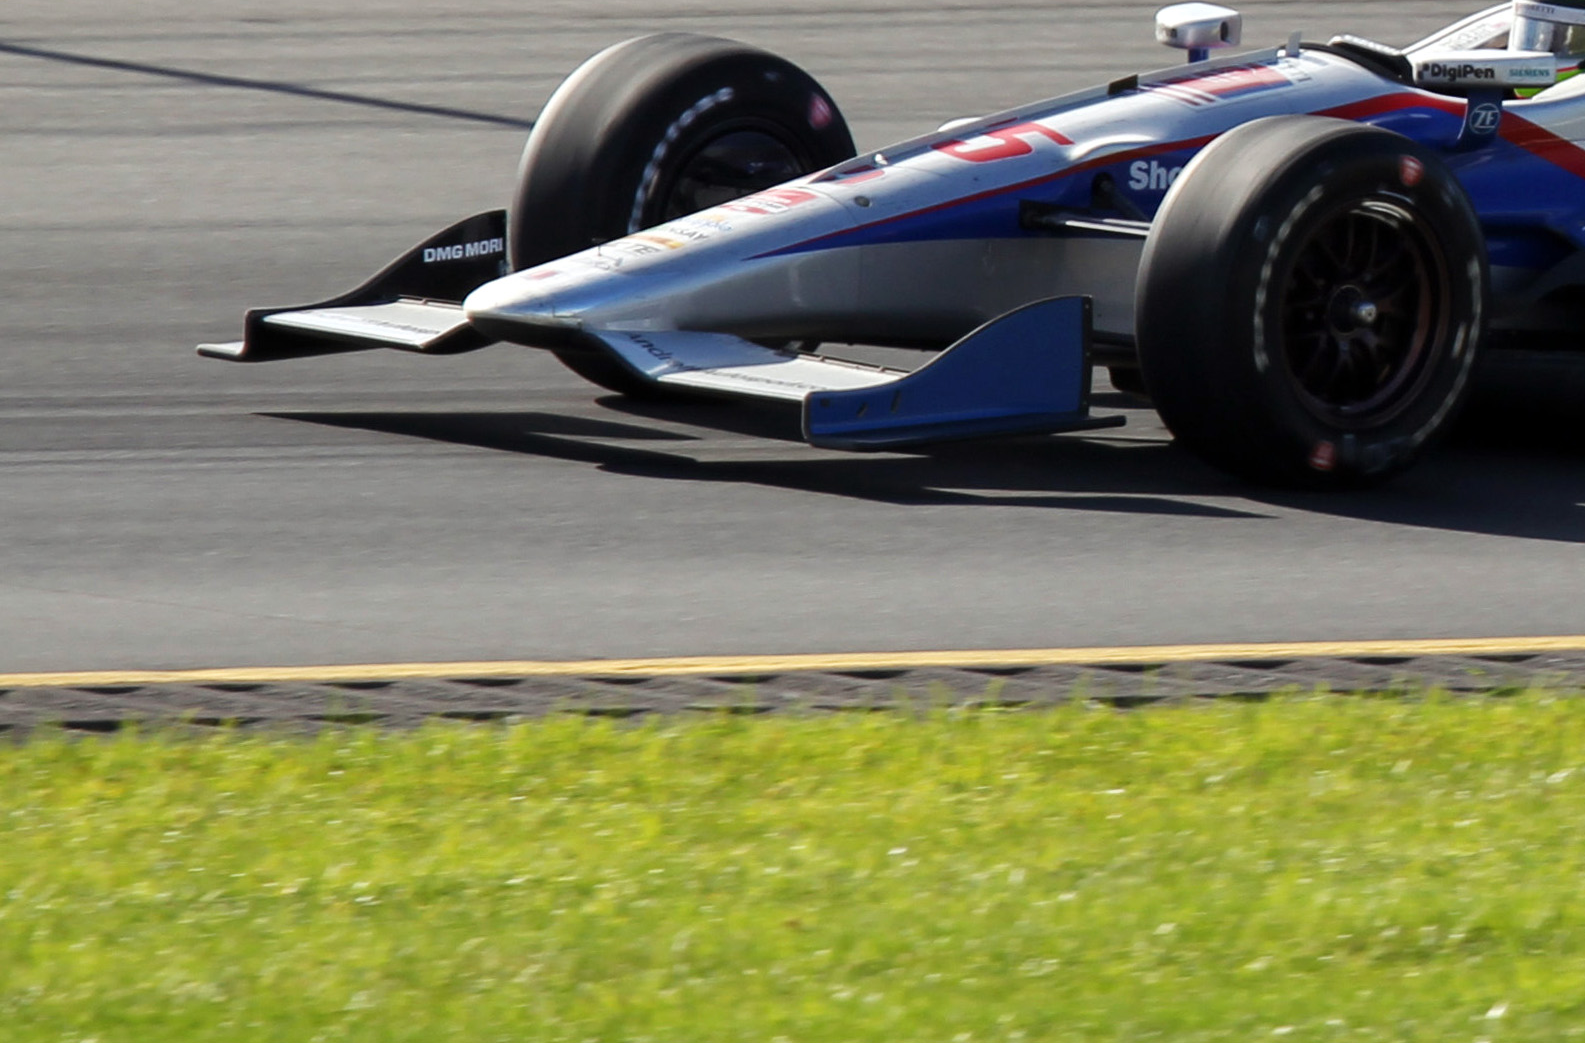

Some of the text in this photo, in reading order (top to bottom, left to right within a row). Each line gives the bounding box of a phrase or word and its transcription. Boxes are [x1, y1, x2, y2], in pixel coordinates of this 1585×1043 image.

[1430, 63, 1495, 82] DigiPen
[1473, 109, 1500, 129] ZF
[423, 237, 503, 263] DMG MORI
